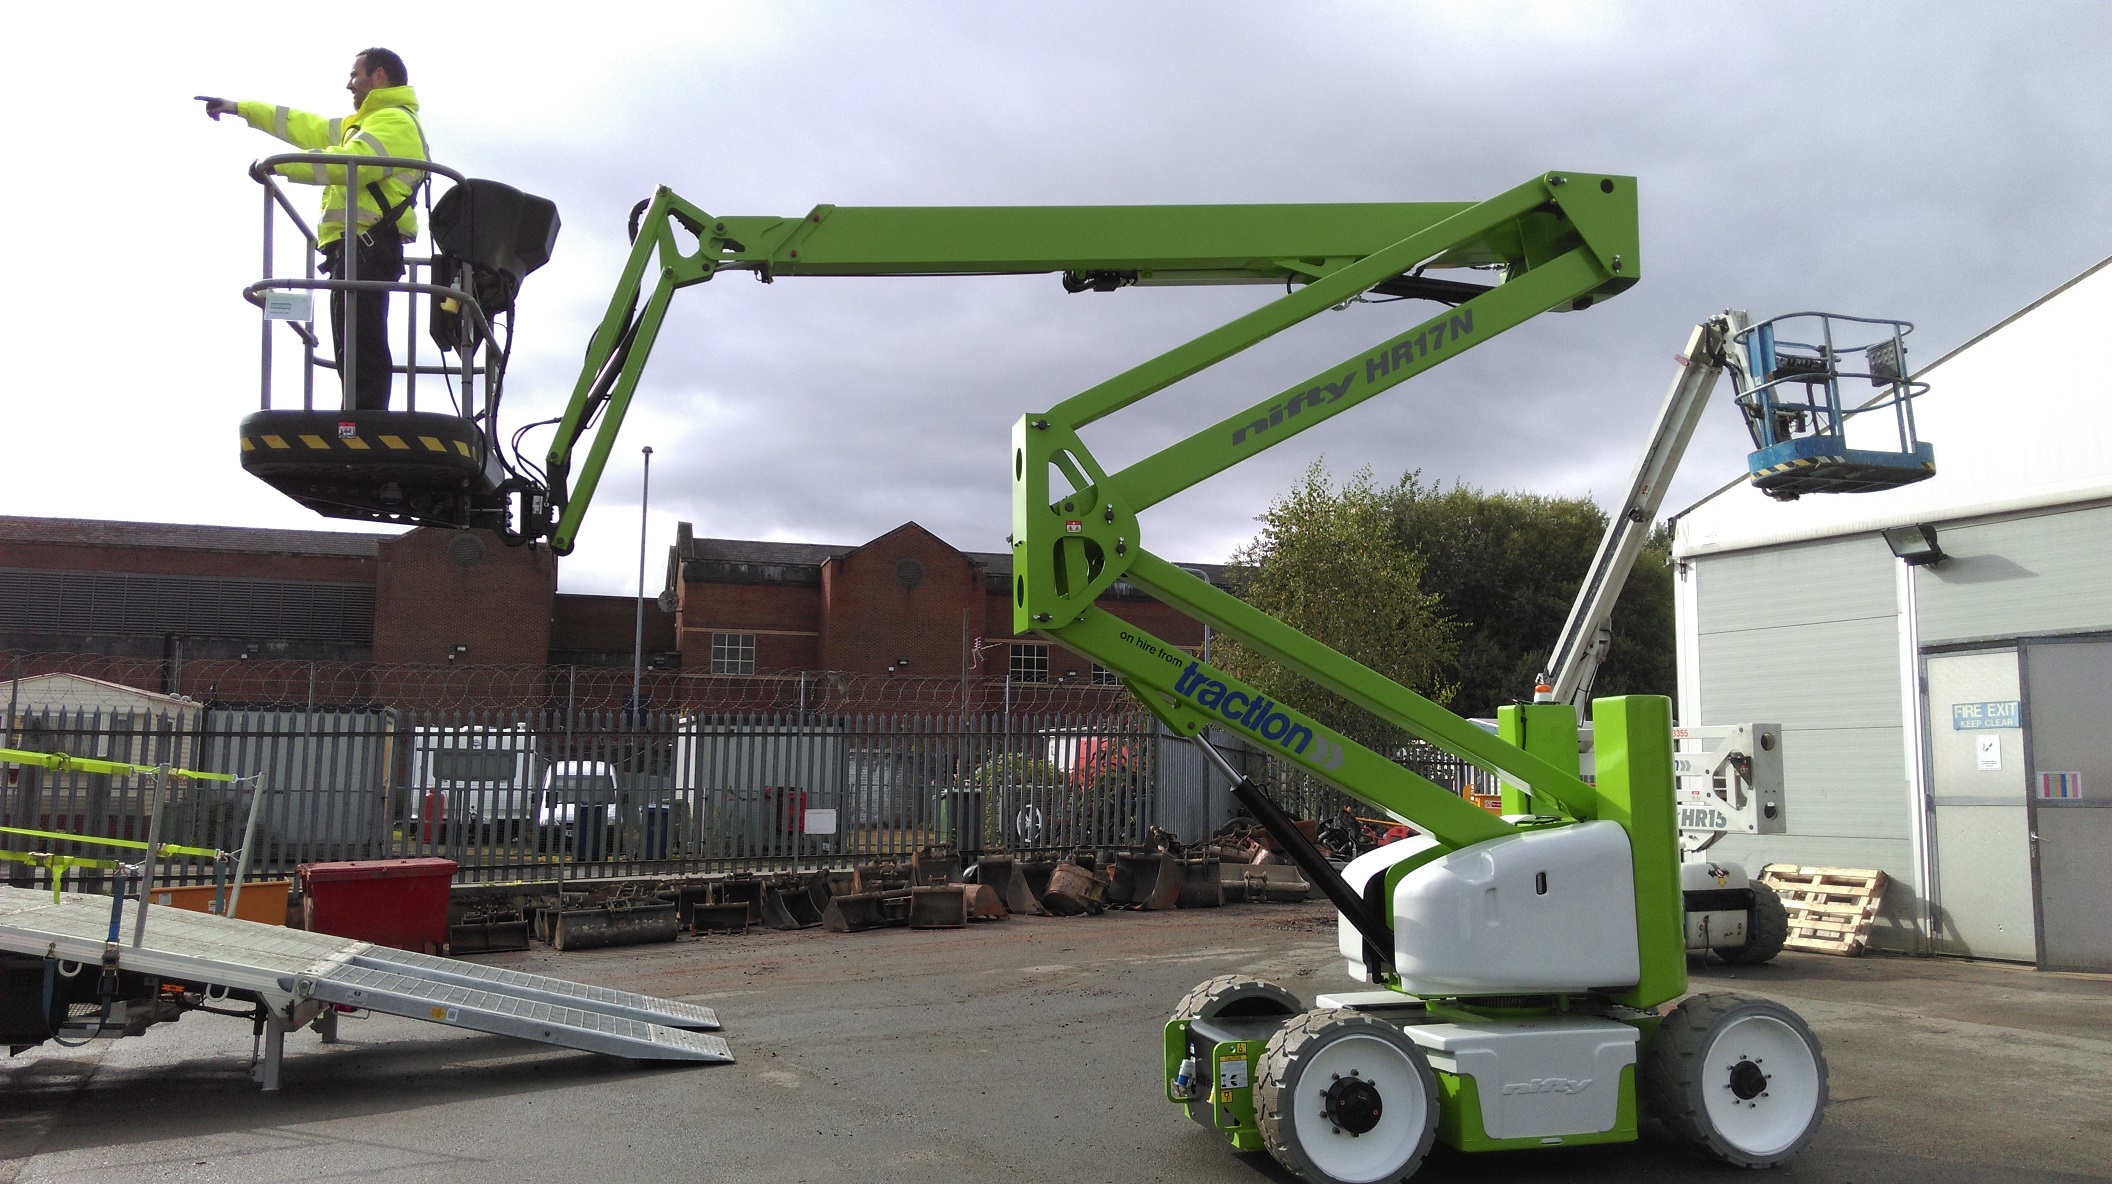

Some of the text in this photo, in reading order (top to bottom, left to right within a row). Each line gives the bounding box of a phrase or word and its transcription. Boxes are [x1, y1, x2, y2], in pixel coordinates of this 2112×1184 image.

[1232, 308, 1474, 446] nifty HR17N
[1119, 631, 1183, 668] on hire from
[1174, 661, 1313, 755] traction
[1954, 702, 2017, 719] FIRE EXIT
[1960, 718, 2013, 728] KEEP CLEAR
